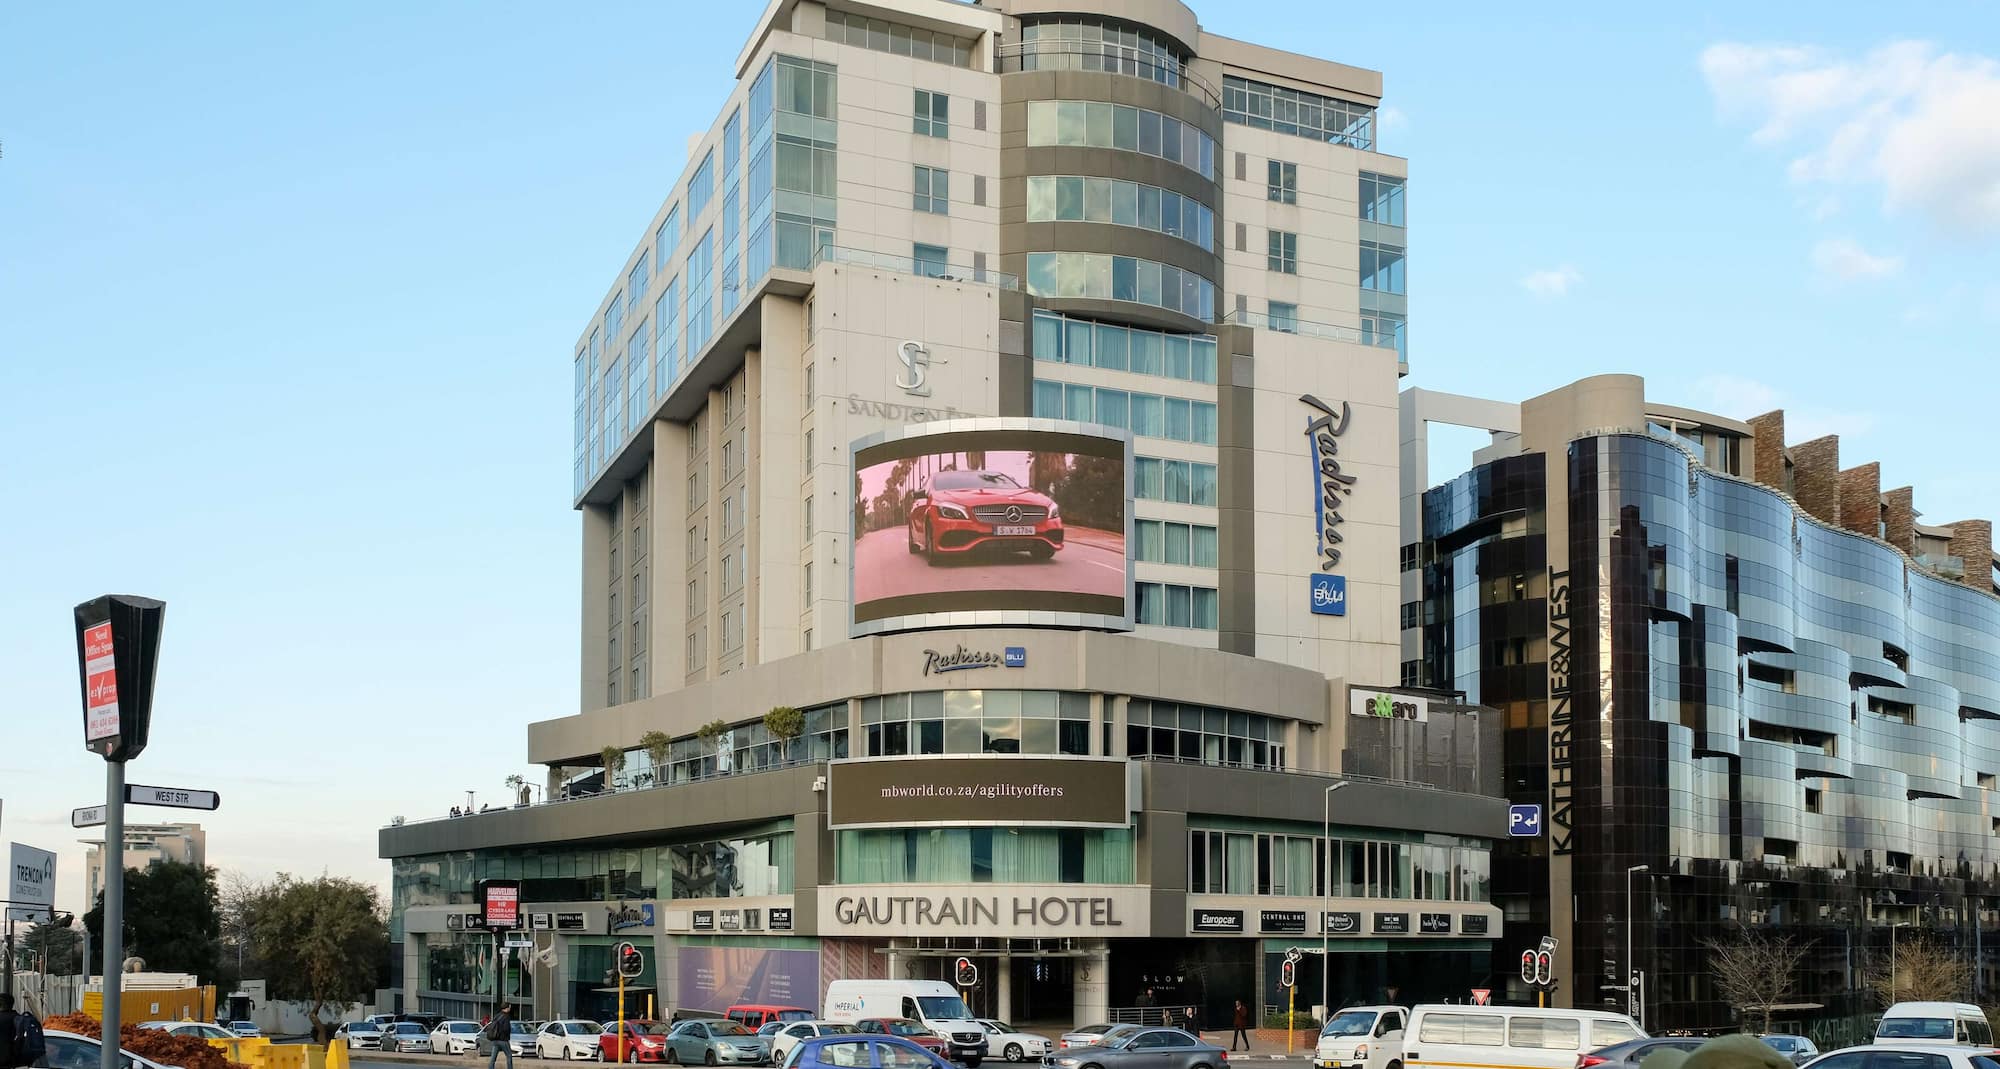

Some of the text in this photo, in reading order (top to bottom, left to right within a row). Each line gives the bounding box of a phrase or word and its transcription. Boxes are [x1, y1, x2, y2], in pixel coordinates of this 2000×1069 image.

[847, 393, 941, 423] SANDTON
[1299, 394, 1357, 571] Radisson
[923, 645, 1024, 677] Radisson BLU
[1366, 694, 1418, 720] exxaro
[1549, 565, 1571, 856] KATHERINE&WEST
[155, 791, 189, 804] WEST STR
[881, 784, 1064, 799] mbworld.co.za/agilityoffers
[1511, 813, 1523, 827] P
[17, 864, 43, 885] TRENCON
[835, 896, 1122, 926] GAUTRAIN HOTEL
[1201, 914, 1236, 926] Europcar
[1143, 975, 1184, 983] SLOW
[834, 1002, 860, 1011] IMPERIAL
